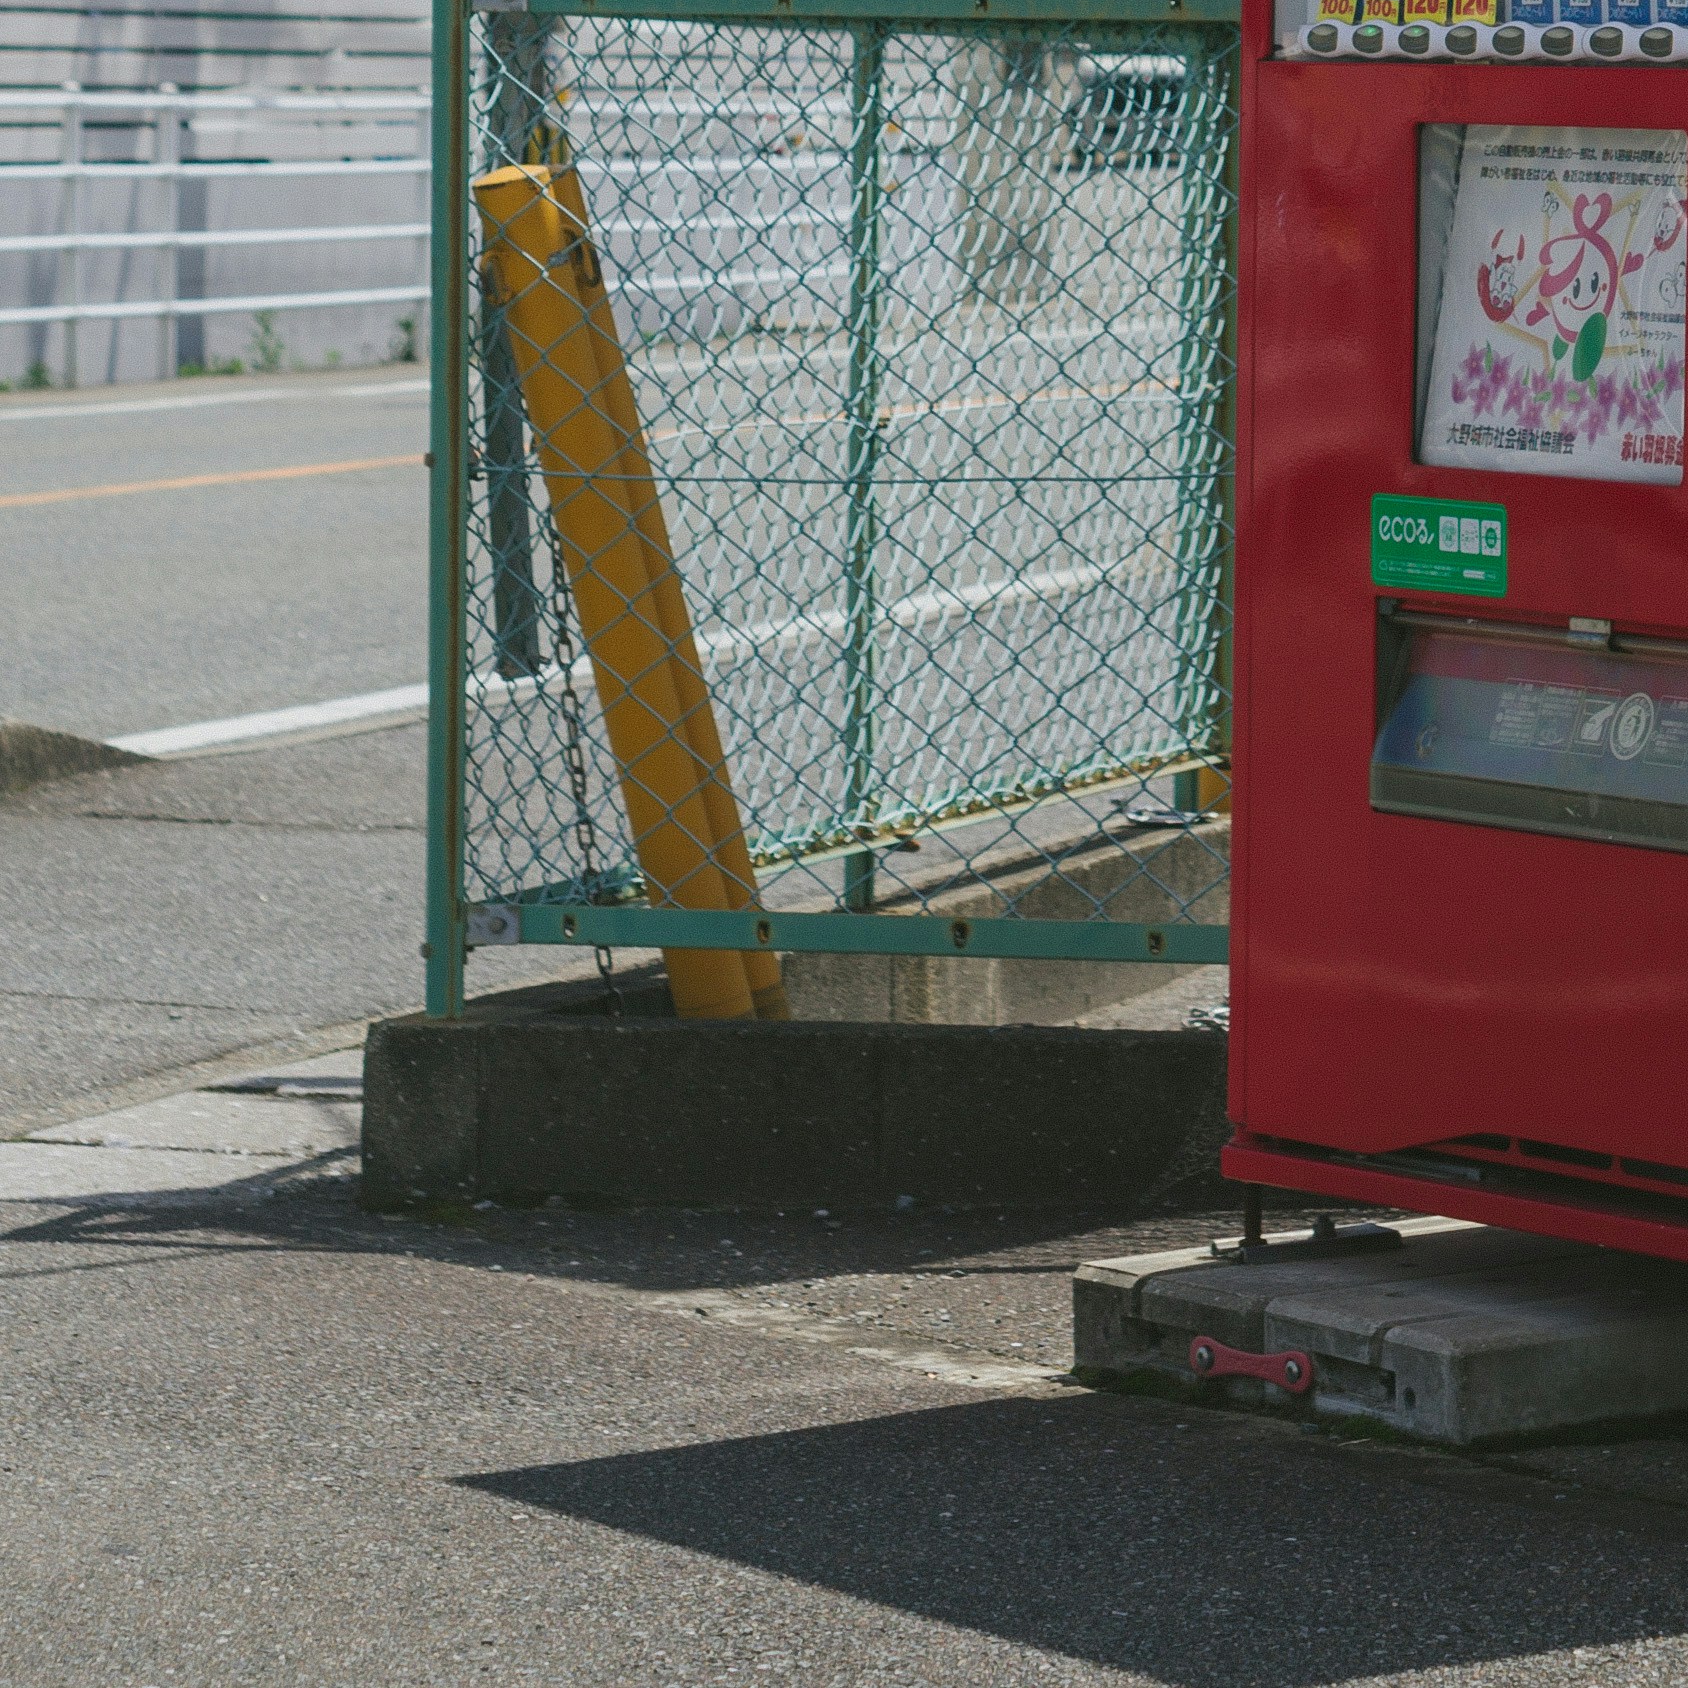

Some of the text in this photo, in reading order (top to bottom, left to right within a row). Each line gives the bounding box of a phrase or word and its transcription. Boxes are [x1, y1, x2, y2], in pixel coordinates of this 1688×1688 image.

[1446, 423, 1576, 455] 大野城市社会福祉協議会
